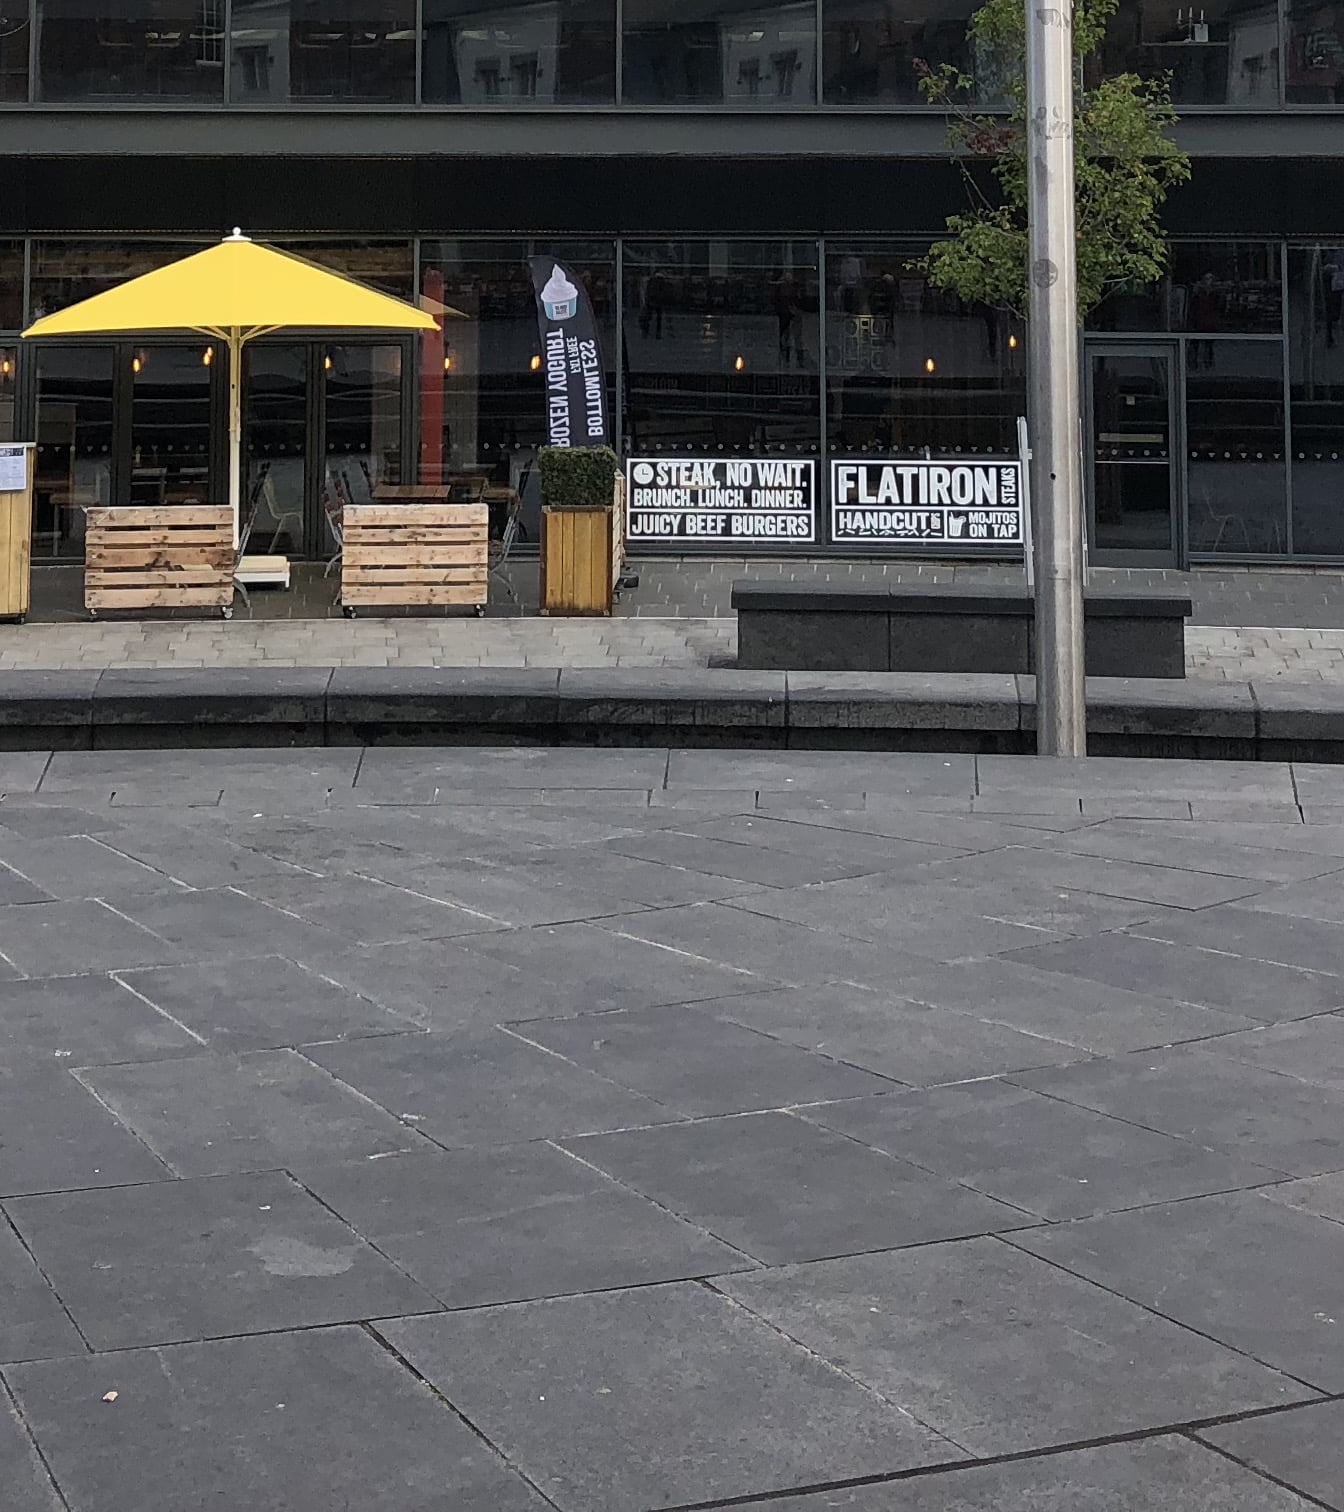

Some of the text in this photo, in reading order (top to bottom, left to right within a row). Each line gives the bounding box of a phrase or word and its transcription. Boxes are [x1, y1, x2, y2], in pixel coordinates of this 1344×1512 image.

[656, 462, 807, 489] STEAK, NO WAIT.
[837, 466, 1016, 505] FLATIRON STEAKS
[633, 488, 807, 508] BRUNCH. LUNCH. DINNER.
[631, 513, 809, 536] JUICY BEEF BURGERS
[838, 511, 929, 530] HANDCUT
[968, 512, 1017, 524] MOJITOS
[969, 524, 1017, 538] ON TAP
